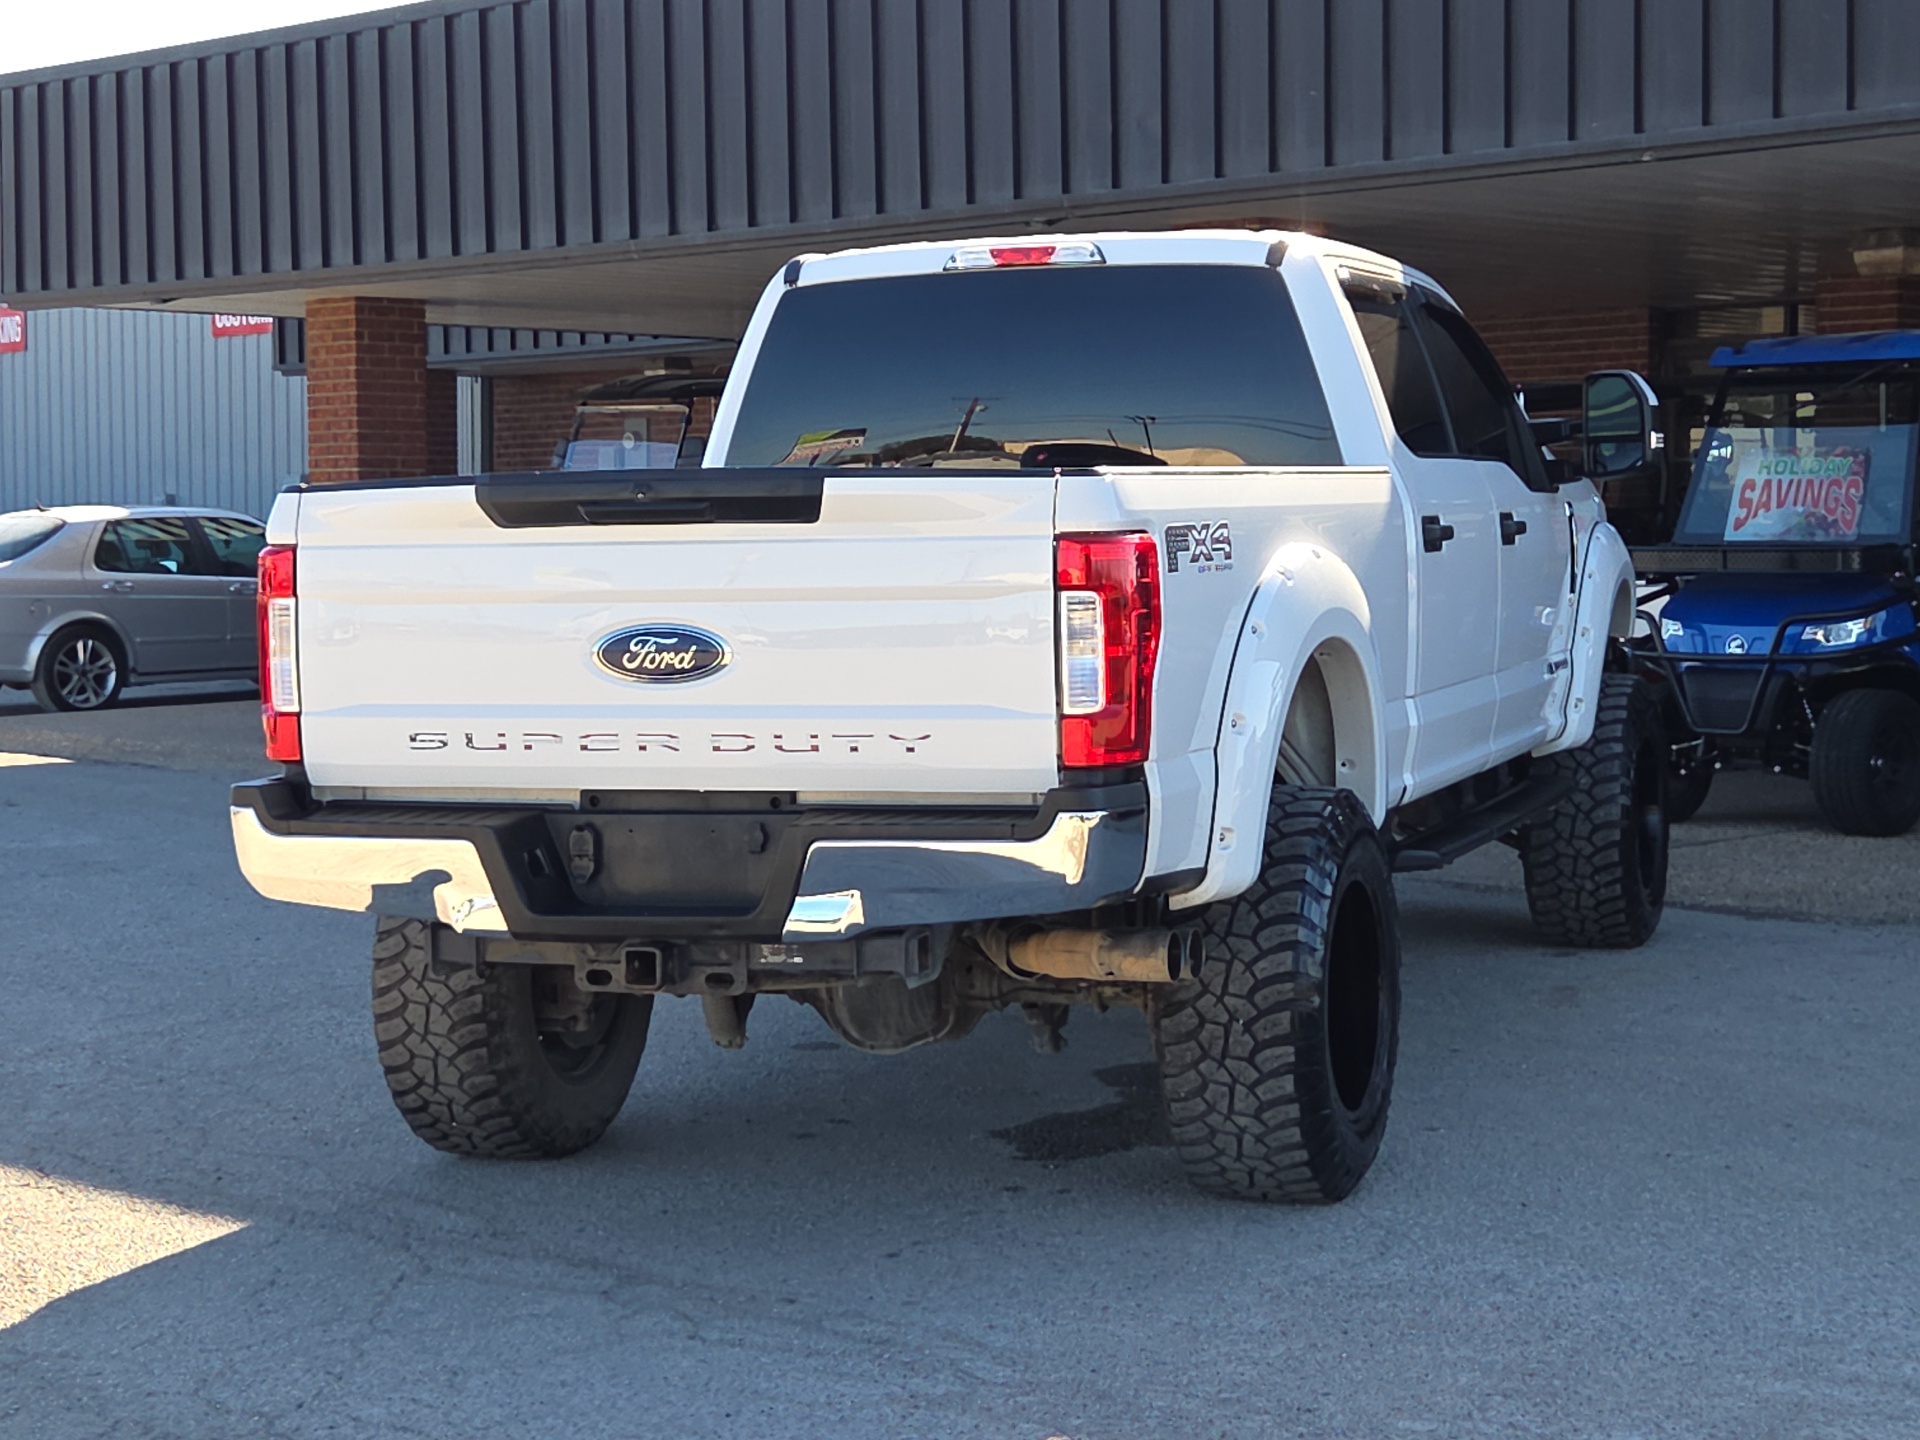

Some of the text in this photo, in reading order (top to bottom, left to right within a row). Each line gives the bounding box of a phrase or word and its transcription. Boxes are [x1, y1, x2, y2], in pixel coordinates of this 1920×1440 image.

[1757, 456, 1853, 476] HOLIDAY
[1732, 475, 1864, 534] SAVINGS
[1164, 521, 1232, 574] FX4
[622, 635, 698, 670] Ford
[409, 732, 932, 753] SUPER DUTY
